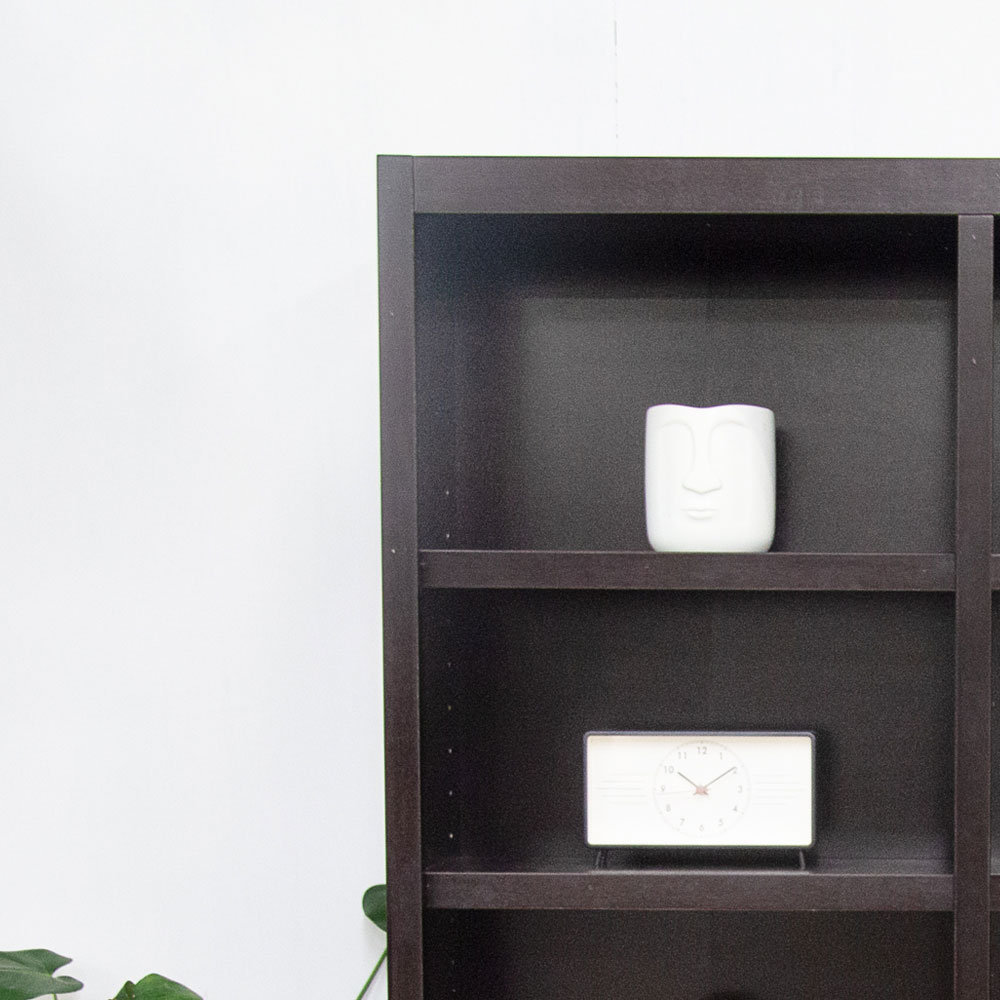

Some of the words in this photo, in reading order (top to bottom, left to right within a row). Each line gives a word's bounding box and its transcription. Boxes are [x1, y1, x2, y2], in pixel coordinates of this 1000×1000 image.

[697, 746, 708, 755] 12
[678, 751, 687, 760] 11
[664, 765, 675, 774] 10
[660, 784, 666, 792] 9
[737, 785, 743, 793] 3
[666, 804, 671, 812] 8
[679, 818, 685, 826] 7
[718, 818, 724, 826] 5
[699, 824, 705, 832] 6
